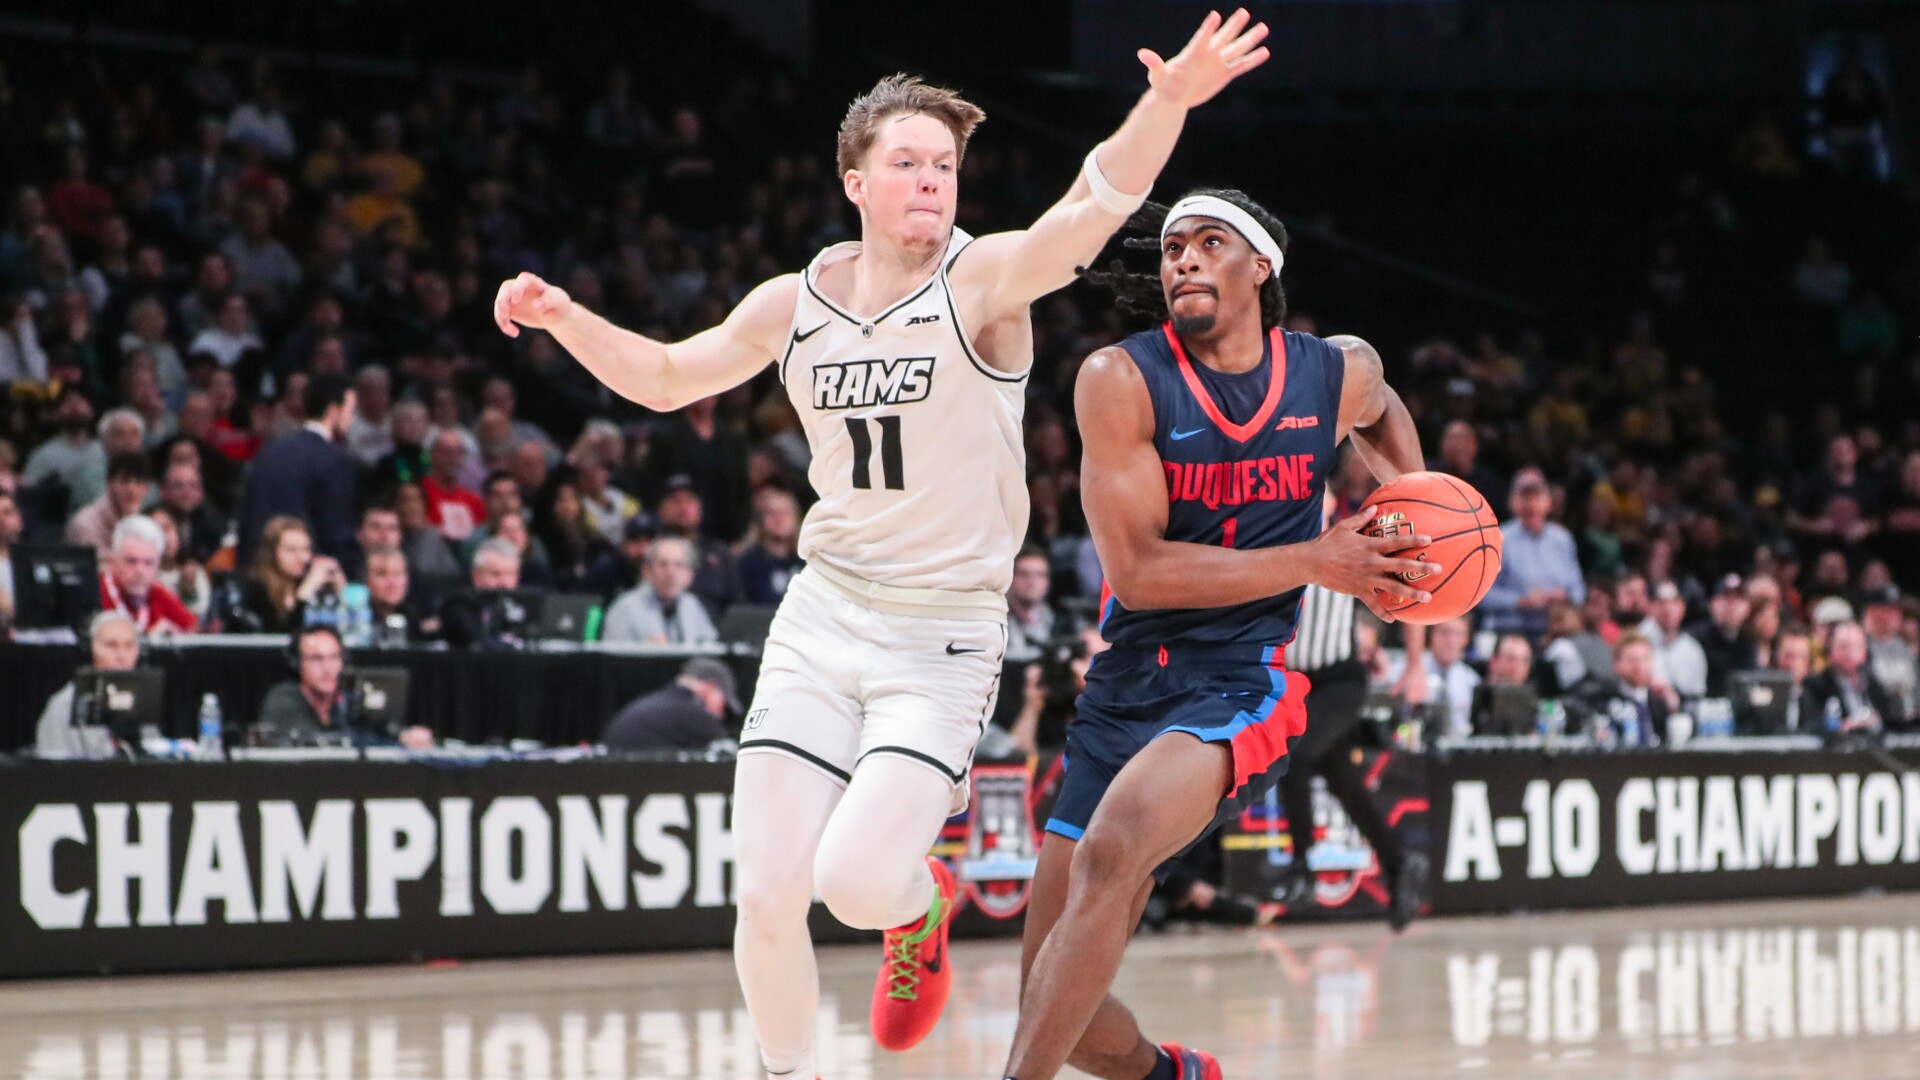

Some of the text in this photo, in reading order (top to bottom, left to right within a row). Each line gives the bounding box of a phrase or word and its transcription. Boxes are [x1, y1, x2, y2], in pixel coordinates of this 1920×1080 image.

[813, 357, 936, 410] RAMS
[845, 415, 905, 491] 11
[1162, 454, 1315, 511] DUQUESNE
[1220, 517, 1238, 549] 1
[743, 708, 769, 732] CU
[1443, 778, 1601, 882] A-10
[18, 793, 737, 930] CHAMPIONSH
